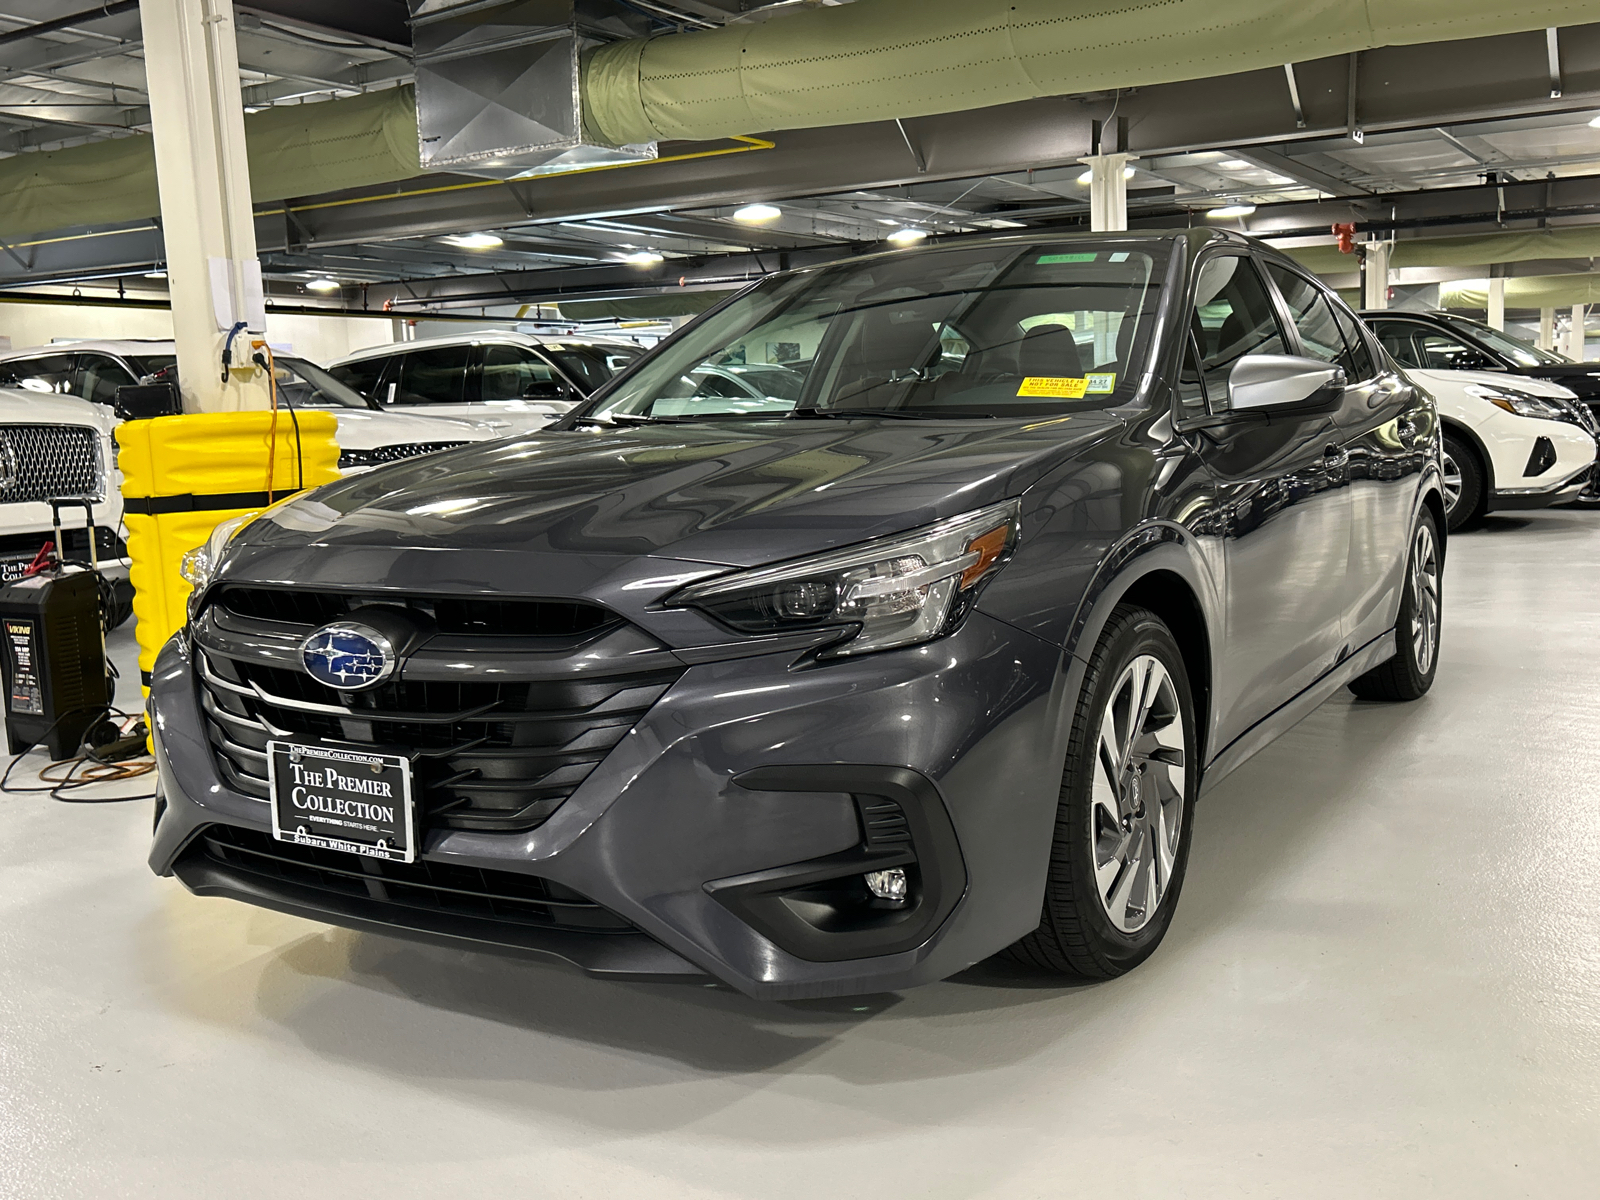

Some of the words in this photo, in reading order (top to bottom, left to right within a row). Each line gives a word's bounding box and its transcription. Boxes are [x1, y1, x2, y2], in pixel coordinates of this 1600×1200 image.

[9, 625, 31, 634] VIKING
[289, 763, 323, 788] THE
[325, 767, 393, 798] PREMIER
[291, 786, 394, 823] COLLECTION
[309, 815, 343, 826] EVERYTHING
[343, 820, 363, 830] STARTS
[294, 834, 327, 847] Subaru
[328, 840, 357, 852] White
[360, 845, 391, 858] Plains
